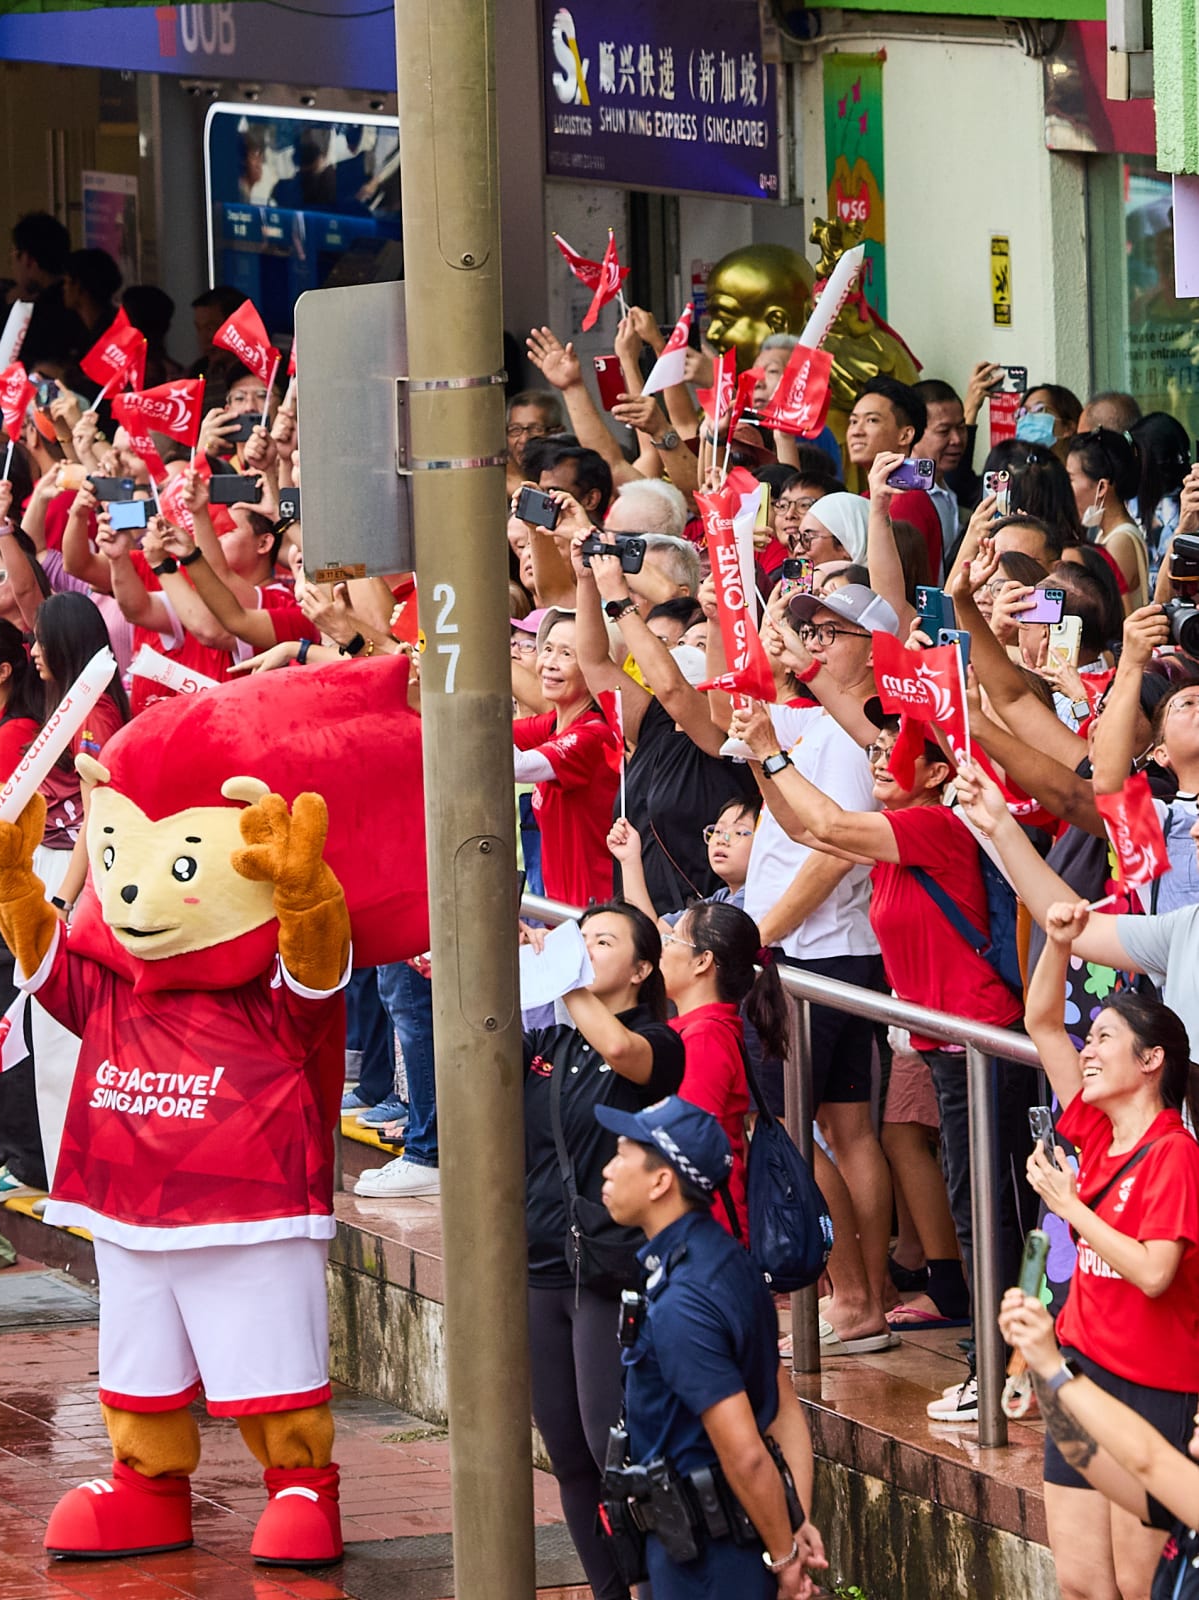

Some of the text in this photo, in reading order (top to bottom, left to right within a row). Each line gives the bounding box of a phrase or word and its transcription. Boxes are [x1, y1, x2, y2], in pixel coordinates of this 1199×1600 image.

[180, 4, 236, 55] UOB
[554, 114, 592, 136] LOGISTICS
[599, 106, 769, 149] SHUN XING EXPRESS (SINGAPORE)
[851, 200, 867, 220] SG
[716, 544, 745, 611] ONE
[89, 1087, 208, 1119] SINGAPORE
